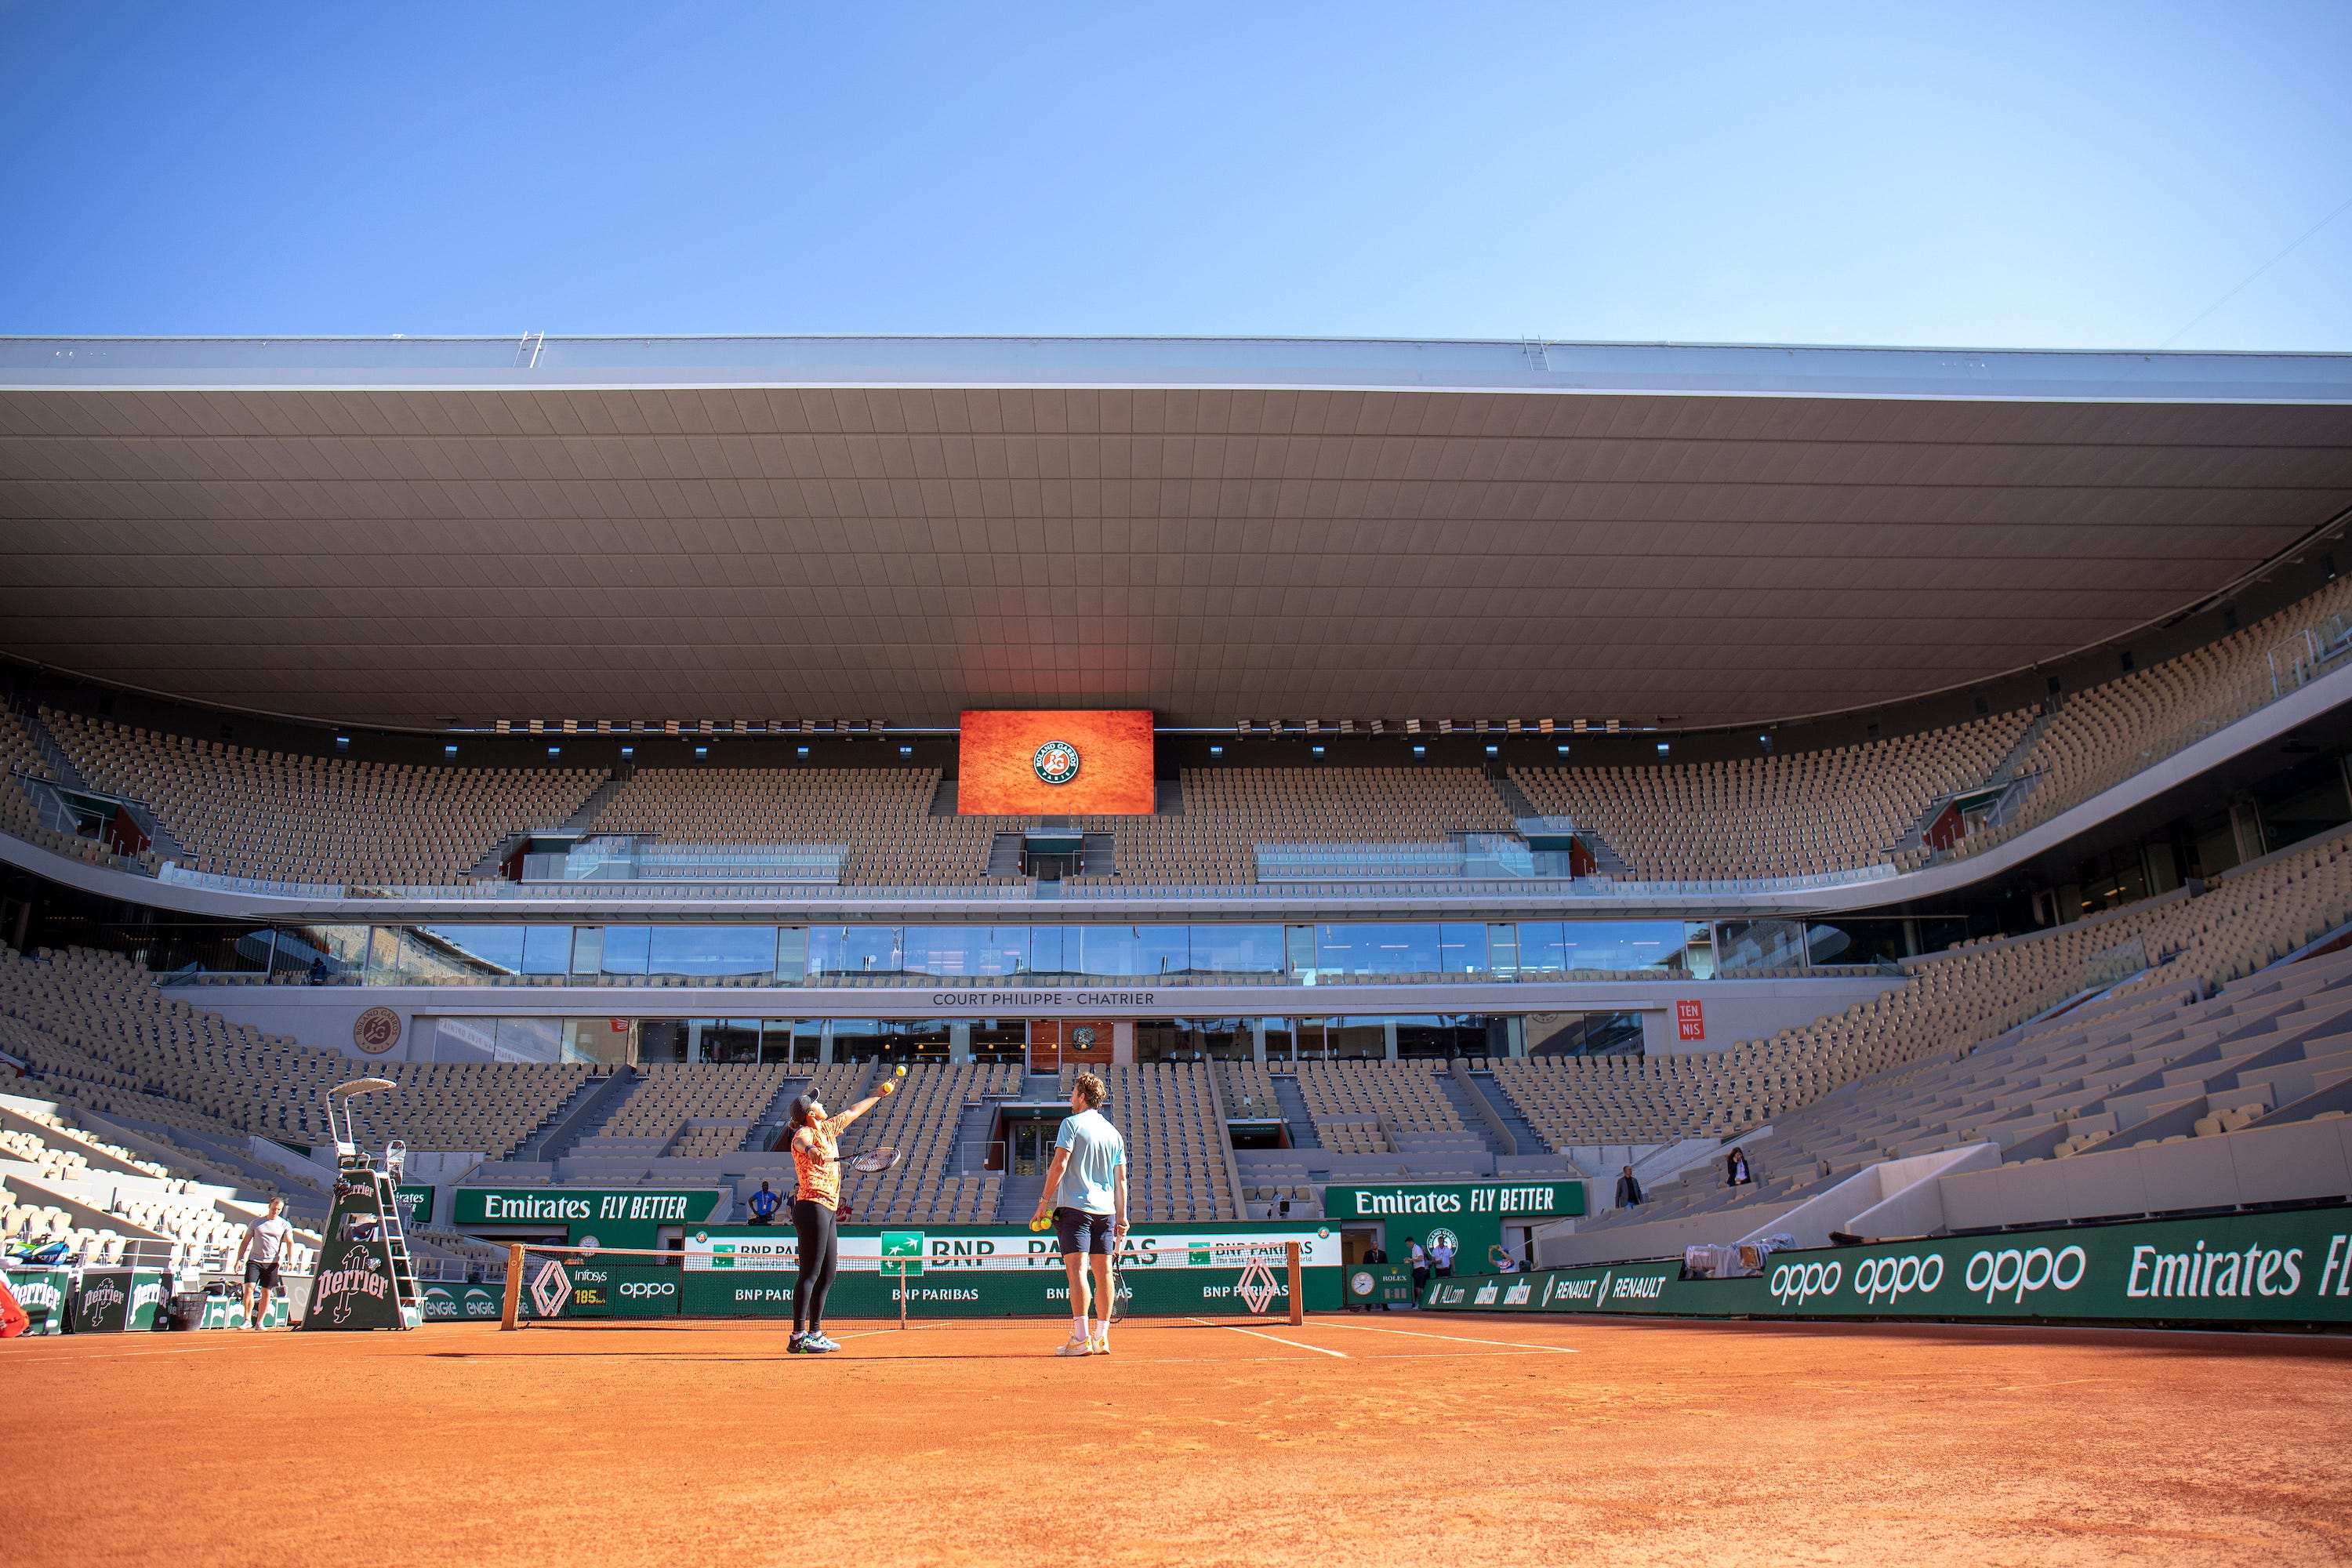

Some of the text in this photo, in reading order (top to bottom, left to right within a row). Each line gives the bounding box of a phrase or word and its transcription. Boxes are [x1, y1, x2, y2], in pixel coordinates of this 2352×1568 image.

[1036, 743, 1076, 767] ROLAND GARROS
[933, 993, 987, 1005] COURT
[992, 993, 1062, 1005] PHILIPPE
[1076, 993, 1154, 1005] CHATRIER
[1679, 1005, 1699, 1017] TEN
[357, 1010, 398, 1036] ROLAND GARROS
[1682, 1023, 1700, 1035] NIS
[394, 1192, 424, 1203] irates
[485, 1194, 688, 1219] Emirates FLY BETTER
[1355, 1187, 1554, 1214] Emirates FLY BETTER
[931, 1239, 1158, 1267] BNP PAAS
[574, 1269, 608, 1283] Infosys
[1965, 1244, 2086, 1305] oppo
[2126, 1234, 2352, 1298] Emirates FL
[619, 1282, 675, 1298] oppo
[1555, 1279, 1597, 1299] RENAULT
[1612, 1276, 1666, 1298] RENAULT
[1769, 1261, 1842, 1306] oppo
[1853, 1254, 1944, 1305] oppo
[129, 1278, 170, 1325] perrier
[314, 1269, 389, 1316] perrier
[575, 1290, 597, 1305] 185
[735, 1288, 763, 1301] BNP
[922, 1288, 978, 1301] PARIBAS
[1203, 1286, 1231, 1298] BNP
